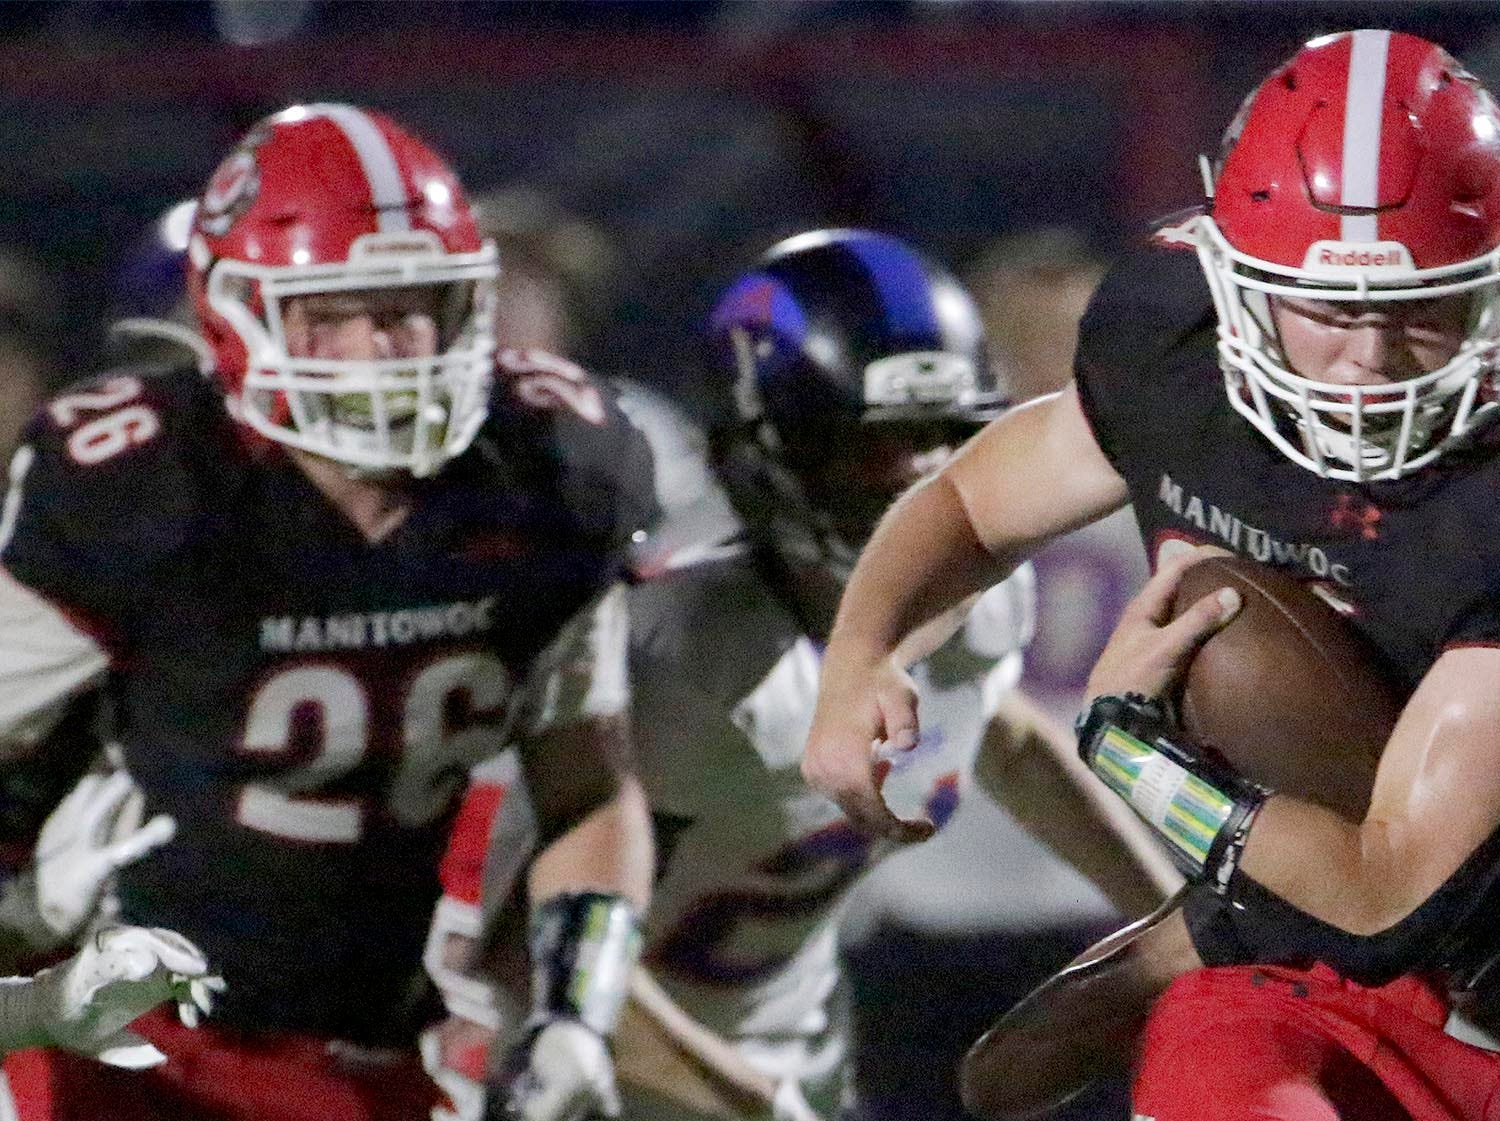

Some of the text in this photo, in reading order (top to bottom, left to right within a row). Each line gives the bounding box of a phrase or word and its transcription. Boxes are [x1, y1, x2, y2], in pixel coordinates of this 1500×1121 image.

[1320, 249, 1401, 266] Riddell
[50, 375, 158, 463] 26
[259, 600, 496, 647] MANITOWOC
[241, 654, 508, 842] 26
